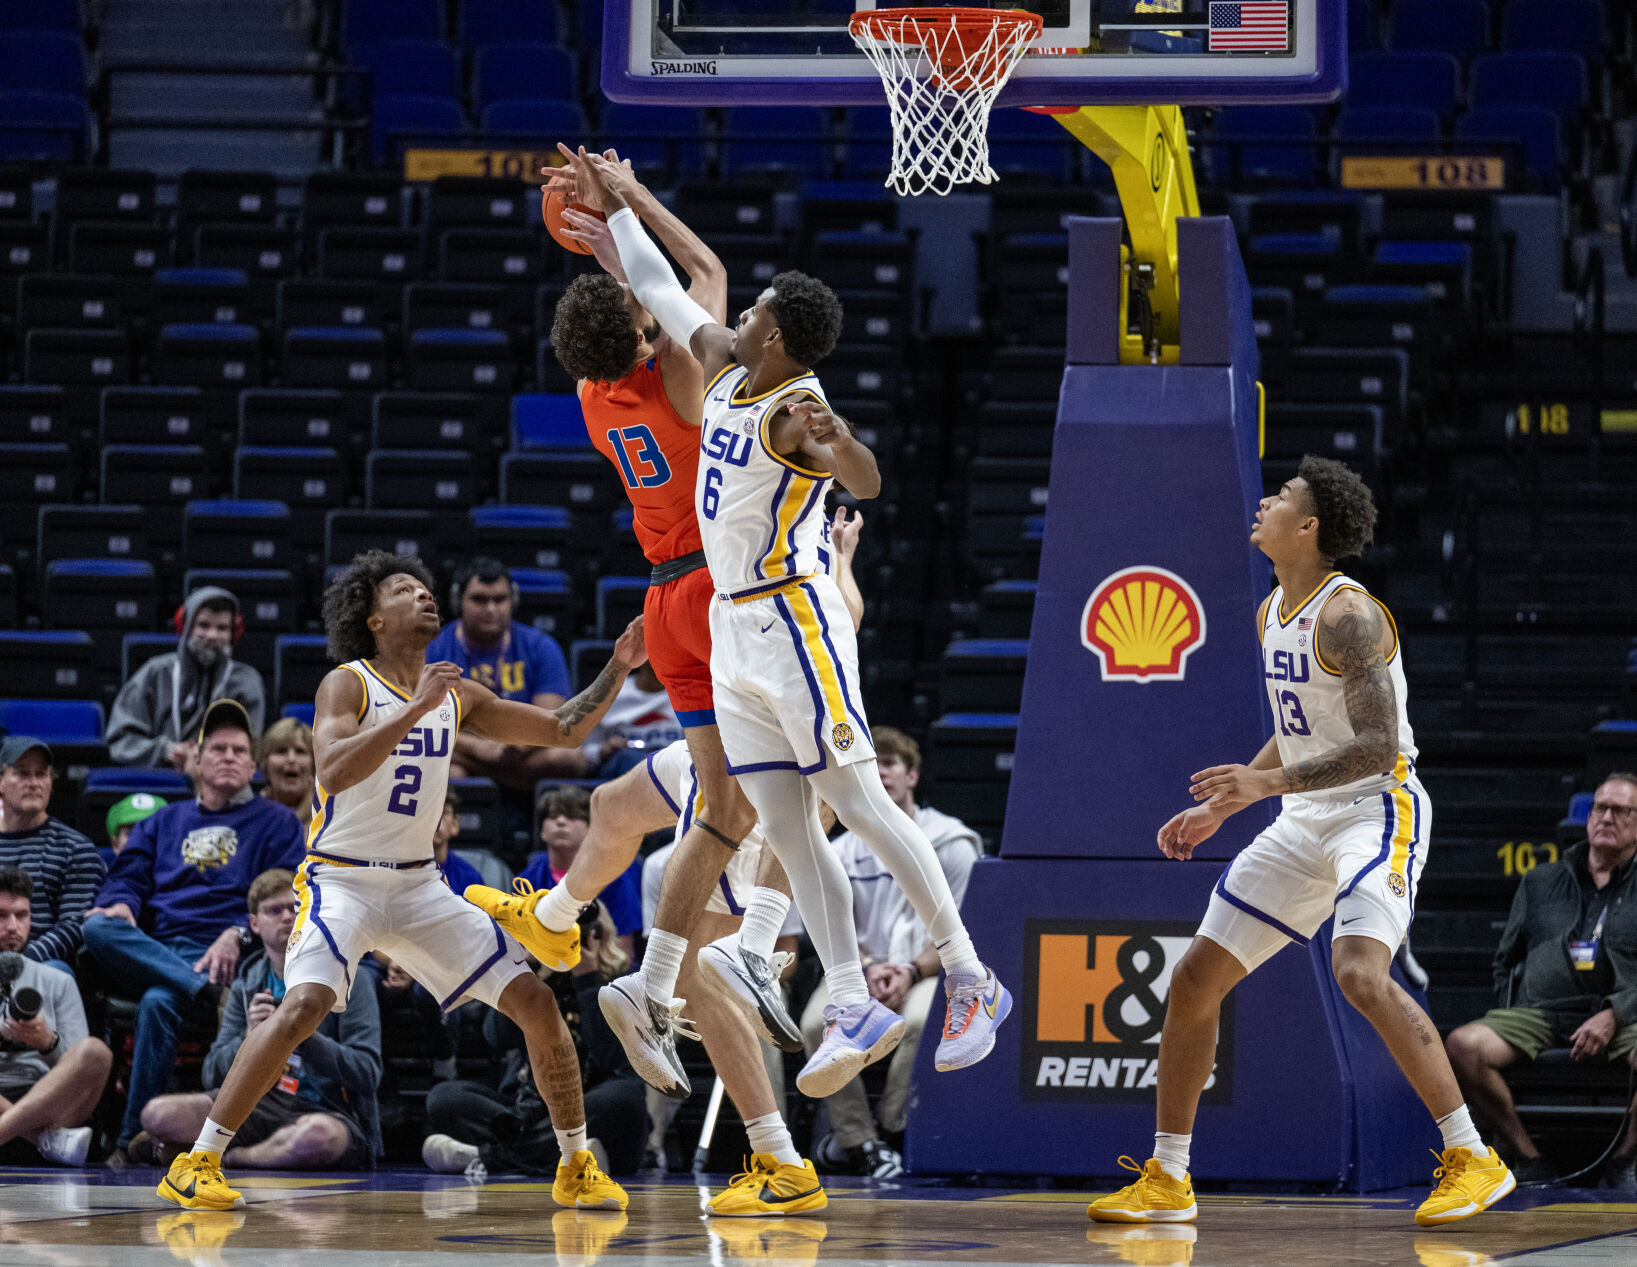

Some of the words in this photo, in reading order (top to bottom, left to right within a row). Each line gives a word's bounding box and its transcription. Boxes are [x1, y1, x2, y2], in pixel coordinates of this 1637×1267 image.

[651, 61, 719, 76] SPALDING
[607, 424, 673, 489] 13
[702, 466, 723, 521] 6
[1263, 647, 1311, 684] LSU
[1275, 688, 1312, 737] 13
[387, 764, 423, 817] 2
[1036, 933, 1220, 1045] H&
